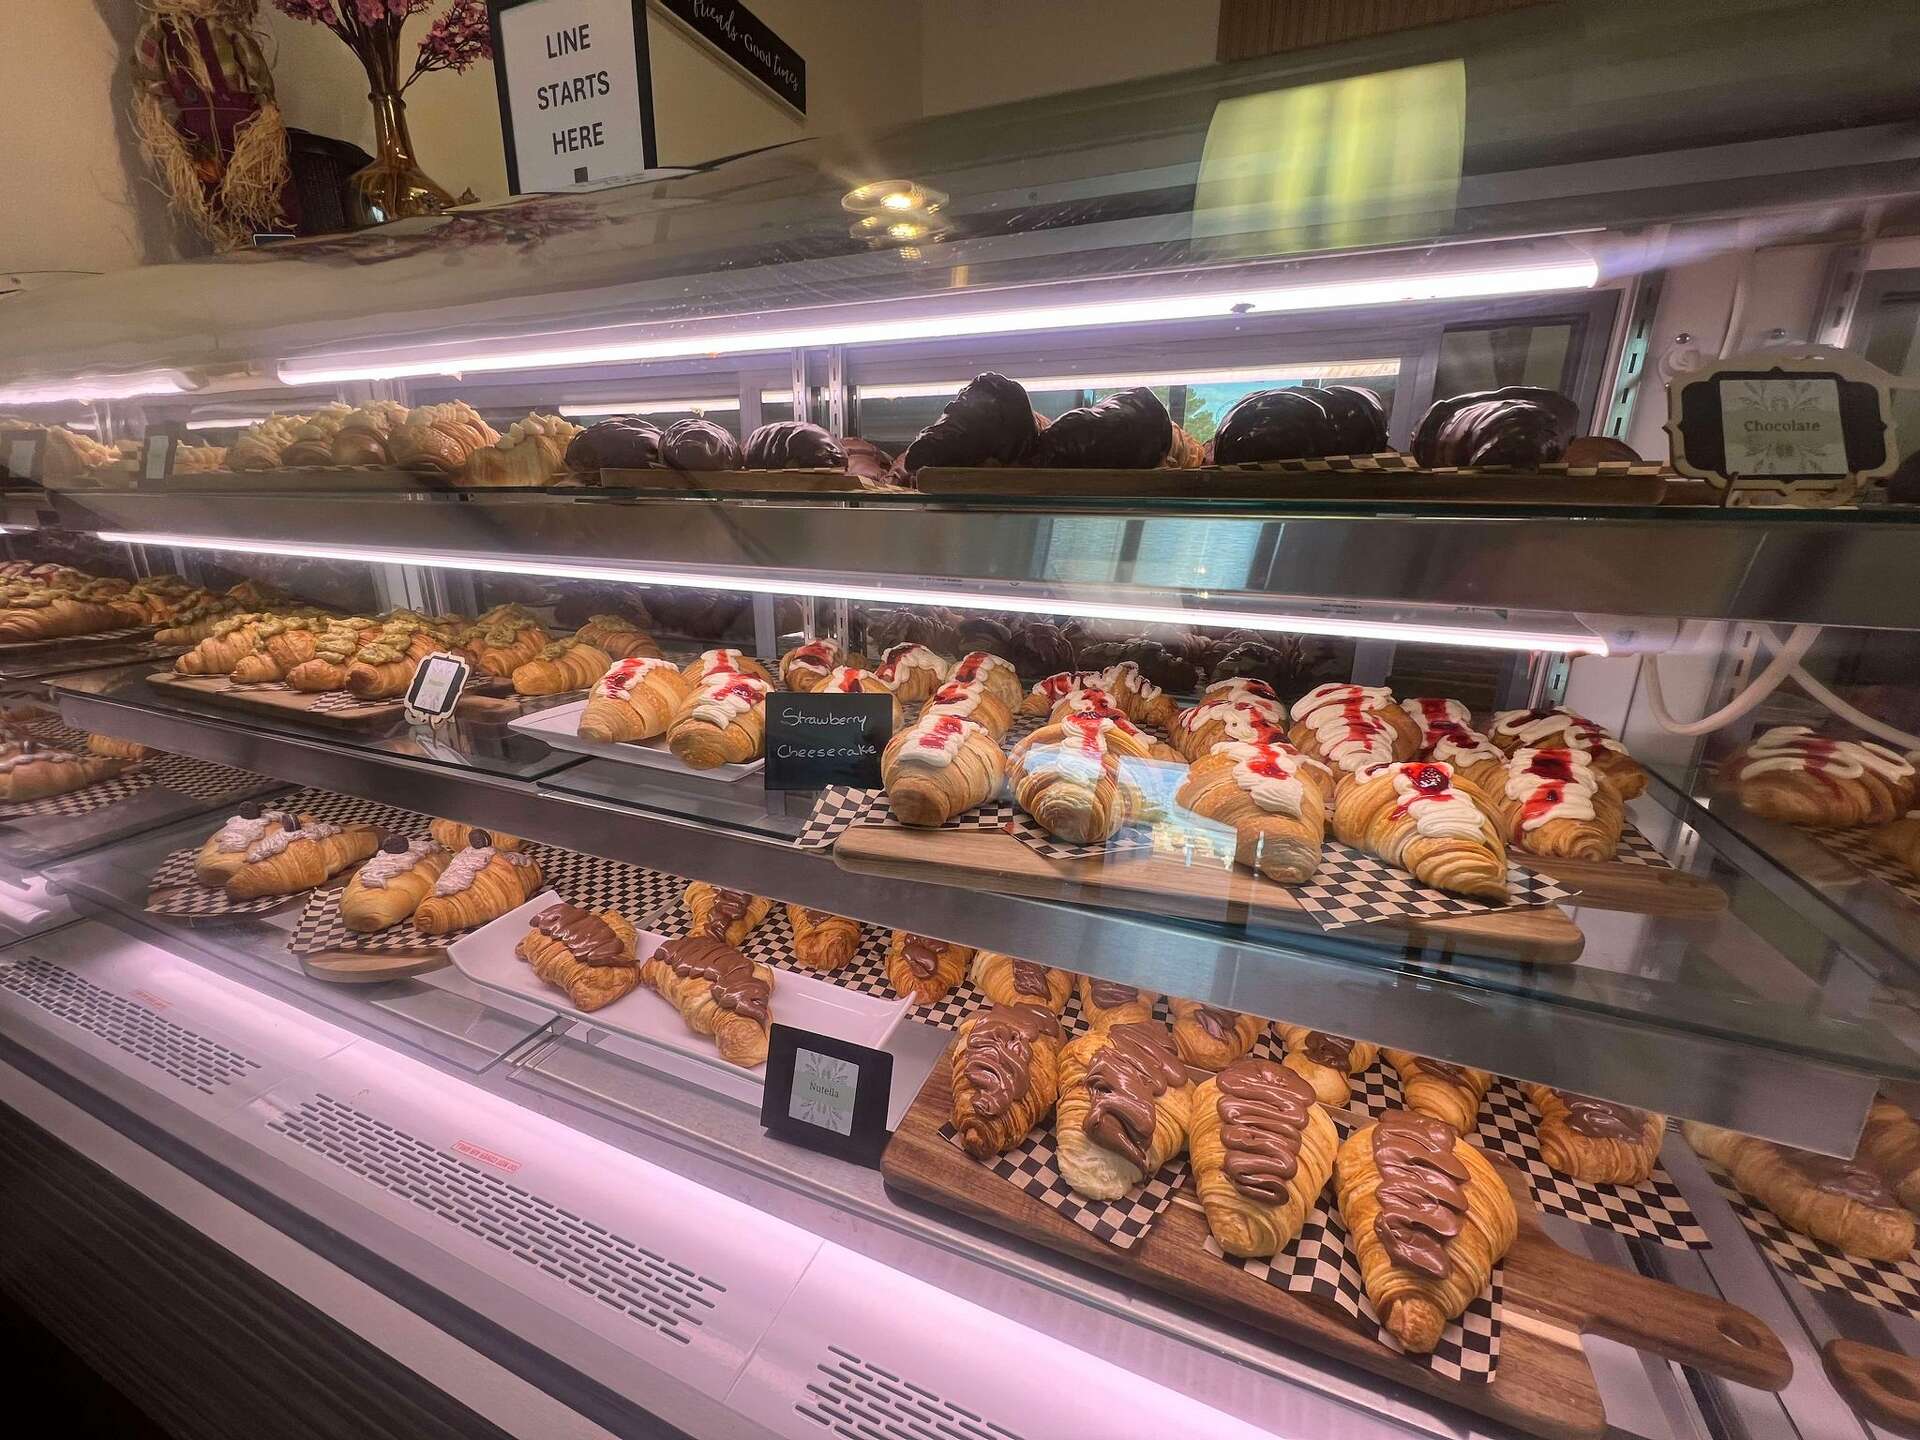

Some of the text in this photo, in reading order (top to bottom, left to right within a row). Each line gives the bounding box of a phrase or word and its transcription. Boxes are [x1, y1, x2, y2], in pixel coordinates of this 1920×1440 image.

[546, 23, 591, 59] LINE
[744, 33, 772, 68] Good
[773, 55, 799, 91] times
[537, 70, 610, 110] STARTS
[552, 121, 604, 155] HERE
[1744, 420, 1821, 432] Chocolate
[782, 707, 867, 732] Strawberry
[777, 744, 876, 758] Cheesecake
[809, 1081, 840, 1098] Nutella
